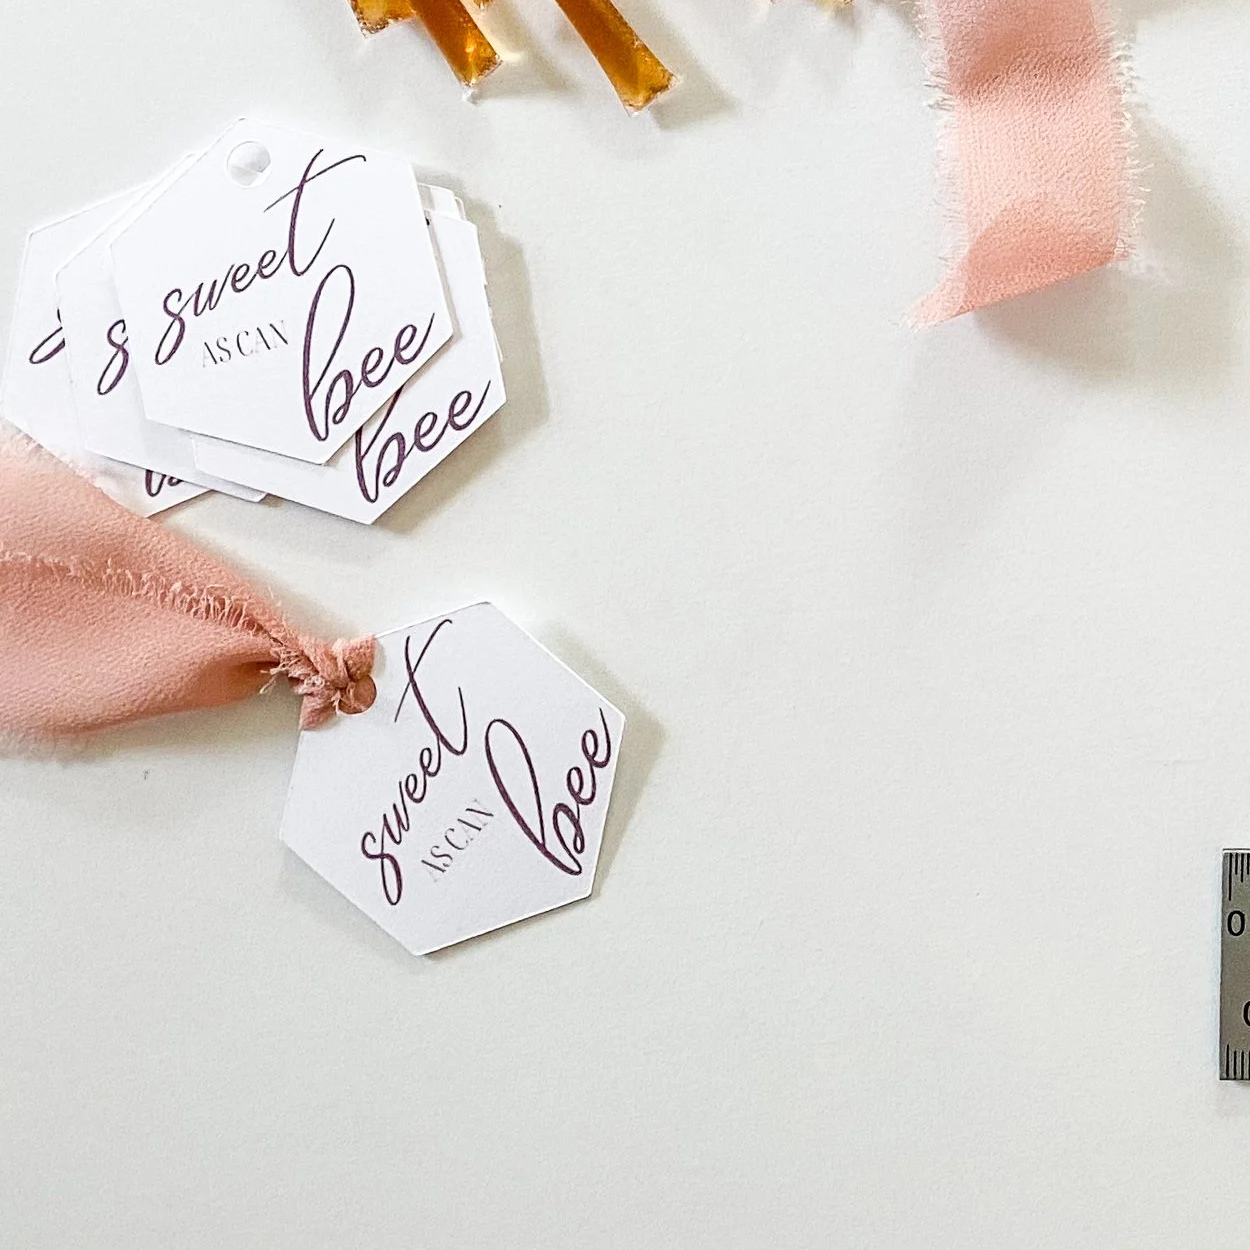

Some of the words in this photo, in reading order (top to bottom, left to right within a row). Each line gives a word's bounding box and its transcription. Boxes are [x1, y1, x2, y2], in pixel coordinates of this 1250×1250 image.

[154, 148, 367, 367] sweet
[302, 263, 437, 443] bee
[360, 618, 468, 907] sweet
[484, 707, 613, 876] bee
[1226, 910, 1246, 937] 0
